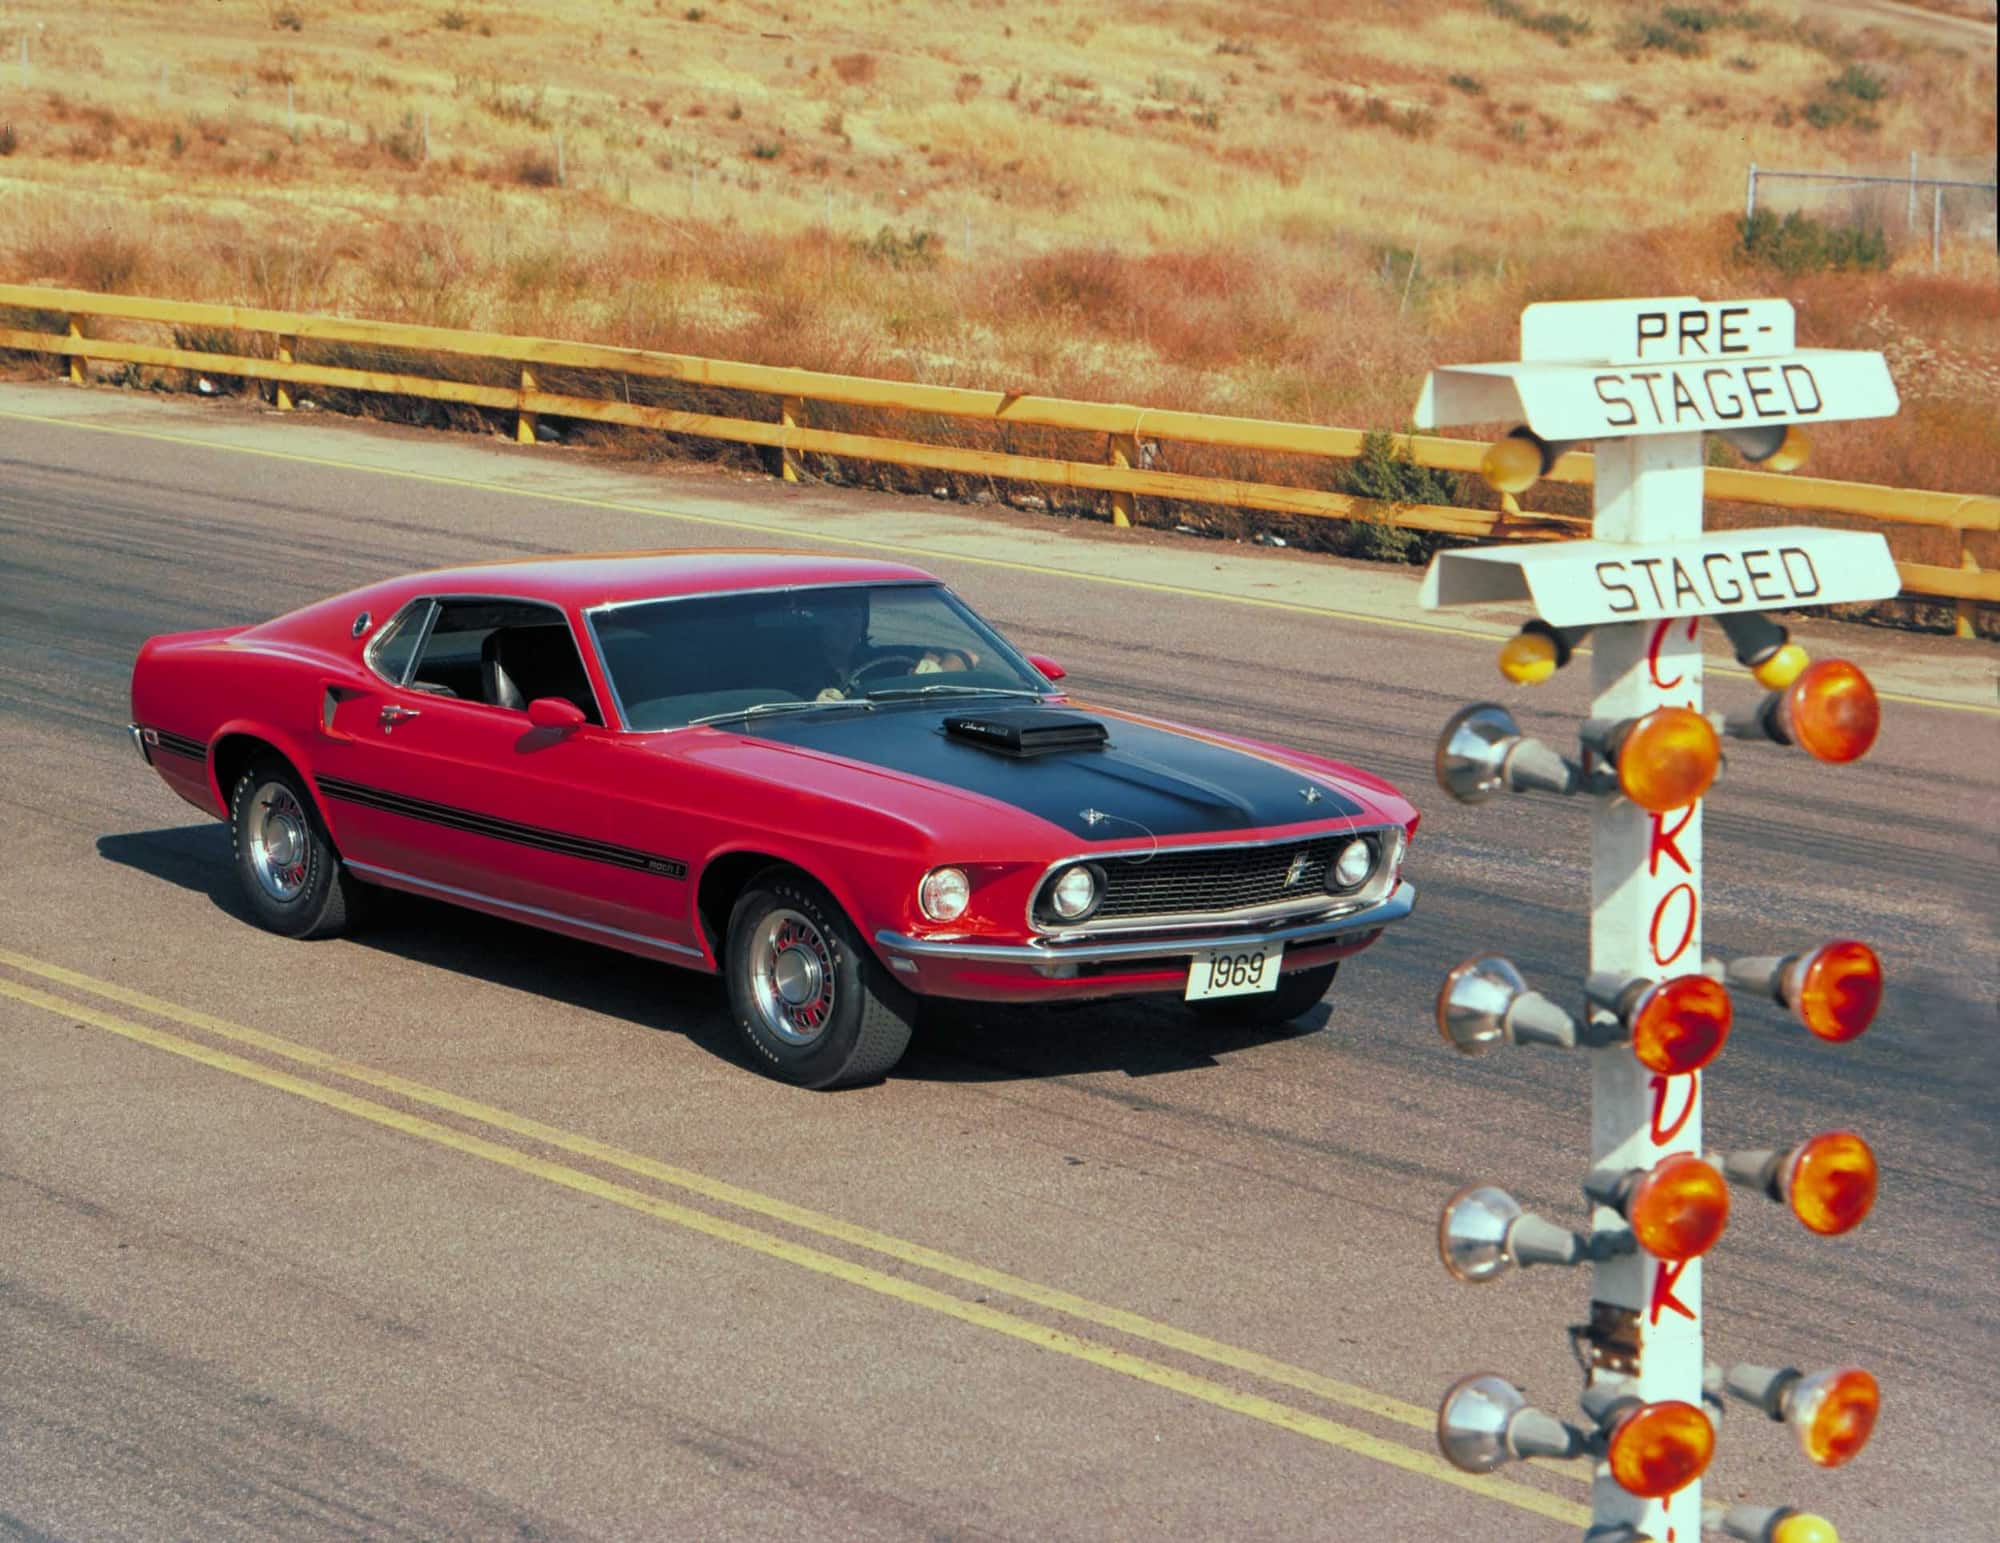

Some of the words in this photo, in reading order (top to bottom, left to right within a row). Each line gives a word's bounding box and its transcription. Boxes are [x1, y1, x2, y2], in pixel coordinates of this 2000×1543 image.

[1636, 307, 1773, 358] PRE-
[1593, 363, 1824, 427] STAGED
[1595, 546, 1821, 613] STAGED
[1207, 952, 1265, 990] 1969
